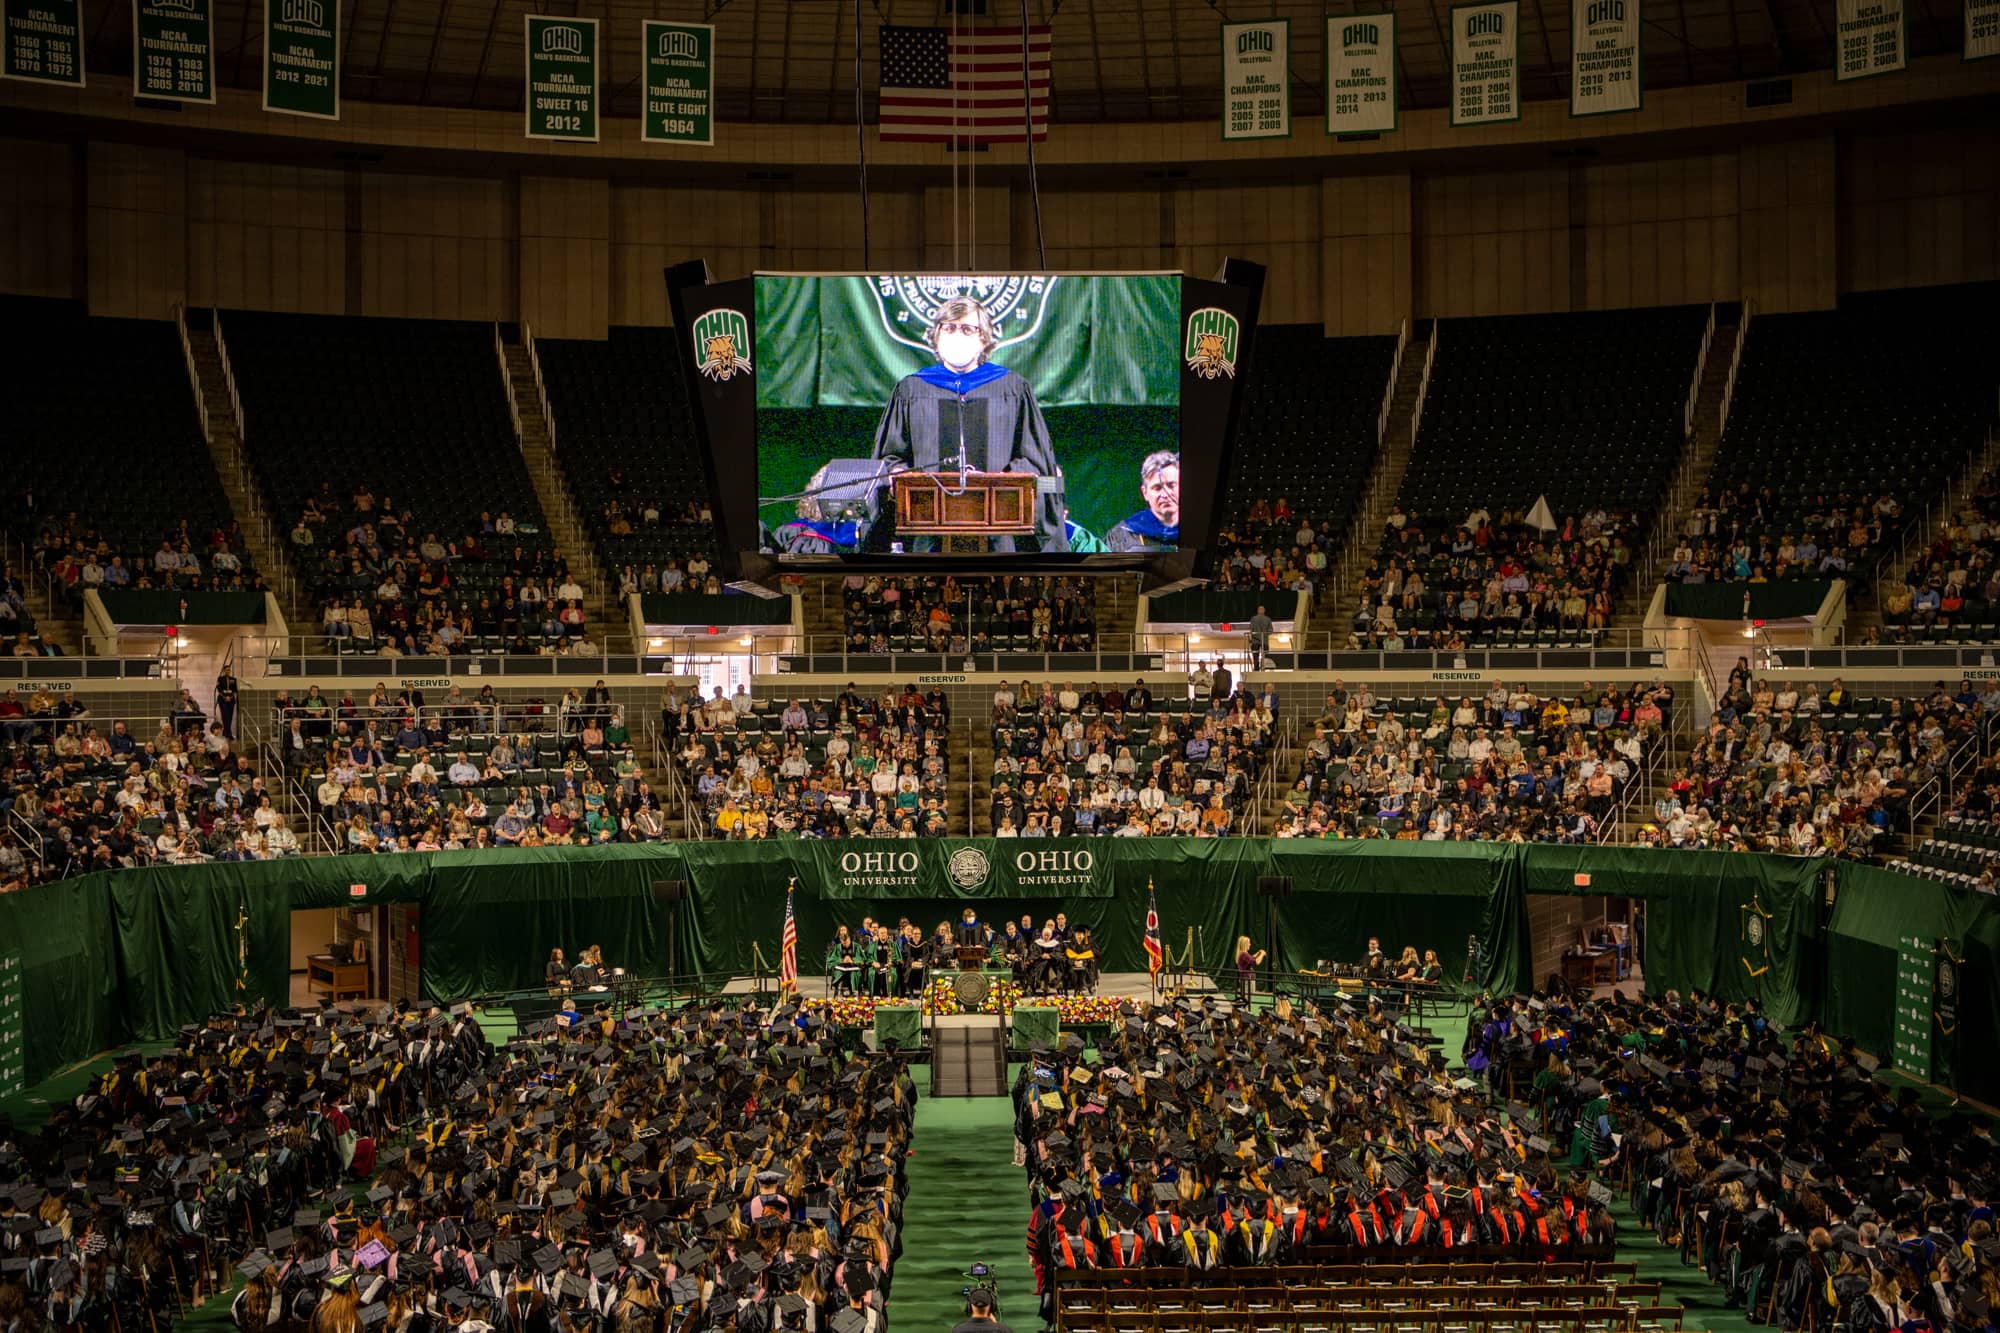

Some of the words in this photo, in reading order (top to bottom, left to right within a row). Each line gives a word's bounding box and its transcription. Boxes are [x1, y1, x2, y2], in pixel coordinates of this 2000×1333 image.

[28, 9, 56, 22] NCAA
[282, 0, 323, 27] OHIO
[1588, 0, 1625, 25] OHIO
[1857, 5, 1882, 18] NCAA
[8, 16, 76, 36] TOURNAMENT
[1467, 13, 1503, 37] OHIO
[1840, 12, 1900, 33] TOURNAMENT
[1972, 12, 1998, 26] 2009
[161, 29, 188, 42] NCAA
[1343, 23, 1379, 48] OHIO
[1972, 25, 1998, 39] 2013
[14, 35, 40, 48] 1960
[45, 40, 71, 52] 1961
[142, 37, 207, 54] TOURNAMENT
[542, 26, 582, 54] OHIO
[659, 31, 698, 59] OHIO
[1238, 30, 1273, 54] OHIO
[1468, 39, 1501, 48] VOLLEYBALL
[1596, 39, 1616, 49] MAC
[1843, 36, 1867, 49] 2003
[1873, 30, 1896, 44] 2004
[14, 47, 40, 60] 1964
[46, 51, 72, 64] 1965
[289, 45, 315, 58] NCAA
[1344, 49, 1377, 57] VOLLEYBALL
[1475, 51, 1495, 61] MAC
[1576, 47, 1635, 63] TOURNAMENT
[1844, 48, 1868, 61] 2005
[147, 55, 172, 67] 1974
[178, 58, 203, 70] 1983
[272, 52, 333, 71] TOURNAMENT
[1239, 56, 1272, 64] VOLLEYBALL
[1456, 58, 1514, 73] TOURNAMENT
[1579, 57, 1632, 73] CHAMPIONS
[1844, 59, 1867, 72] 2007
[14, 59, 40, 72] 1970
[46, 63, 72, 76] 1972
[147, 66, 172, 78] 1985
[178, 69, 203, 82] 1994
[1351, 68, 1371, 77] MAC
[275, 69, 300, 83] 2012
[304, 73, 328, 87] 2021
[550, 74, 574, 84] NCAA
[667, 78, 690, 88] NCAA
[1246, 75, 1265, 84] MAC
[1335, 77, 1387, 89] CHAMPIONS
[1459, 69, 1511, 83] CHAMPIONS
[1580, 74, 1603, 86] 2010
[1608, 71, 1631, 82] 2013
[147, 78, 172, 90] 2005
[178, 81, 204, 93] 2010
[533, 82, 592, 95] TOURNAMENT
[650, 86, 707, 99] TOURNAMENT
[1231, 83, 1281, 95] CHAMPIONS
[1460, 85, 1483, 96] 2003
[1487, 82, 1510, 93] 2004
[1580, 86, 1603, 97] 2015
[537, 98, 571, 111] SWEET
[575, 99, 588, 112] 16
[1231, 101, 1253, 111] 2003
[1258, 99, 1281, 109] 2004
[1336, 94, 1359, 104] 2012
[1364, 92, 1386, 102] 2013
[1460, 96, 1483, 107] 2005
[650, 101, 675, 113] ELITE
[678, 102, 707, 116] EIGHT
[1336, 105, 1359, 114] 2014
[546, 115, 581, 131] 2012
[1231, 111, 1253, 121] 2005
[662, 119, 695, 134] 1964
[1231, 122, 1253, 131] 2007
[903, 281, 929, 313] PRAE
[986, 276, 1020, 317] VIRTUS
[693, 309, 750, 369] OHIO
[1185, 307, 1239, 366] OHIO
[920, 675, 966, 683] RESERVED
[1432, 672, 1481, 680] RESERVED
[17, 682, 72, 691] RESVED
[841, 852, 919, 873] OHIO
[1016, 850, 1093, 872] OHIO
[844, 876, 917, 887] UNIVERSITY
[1018, 875, 1092, 886] UNIVERSITY
